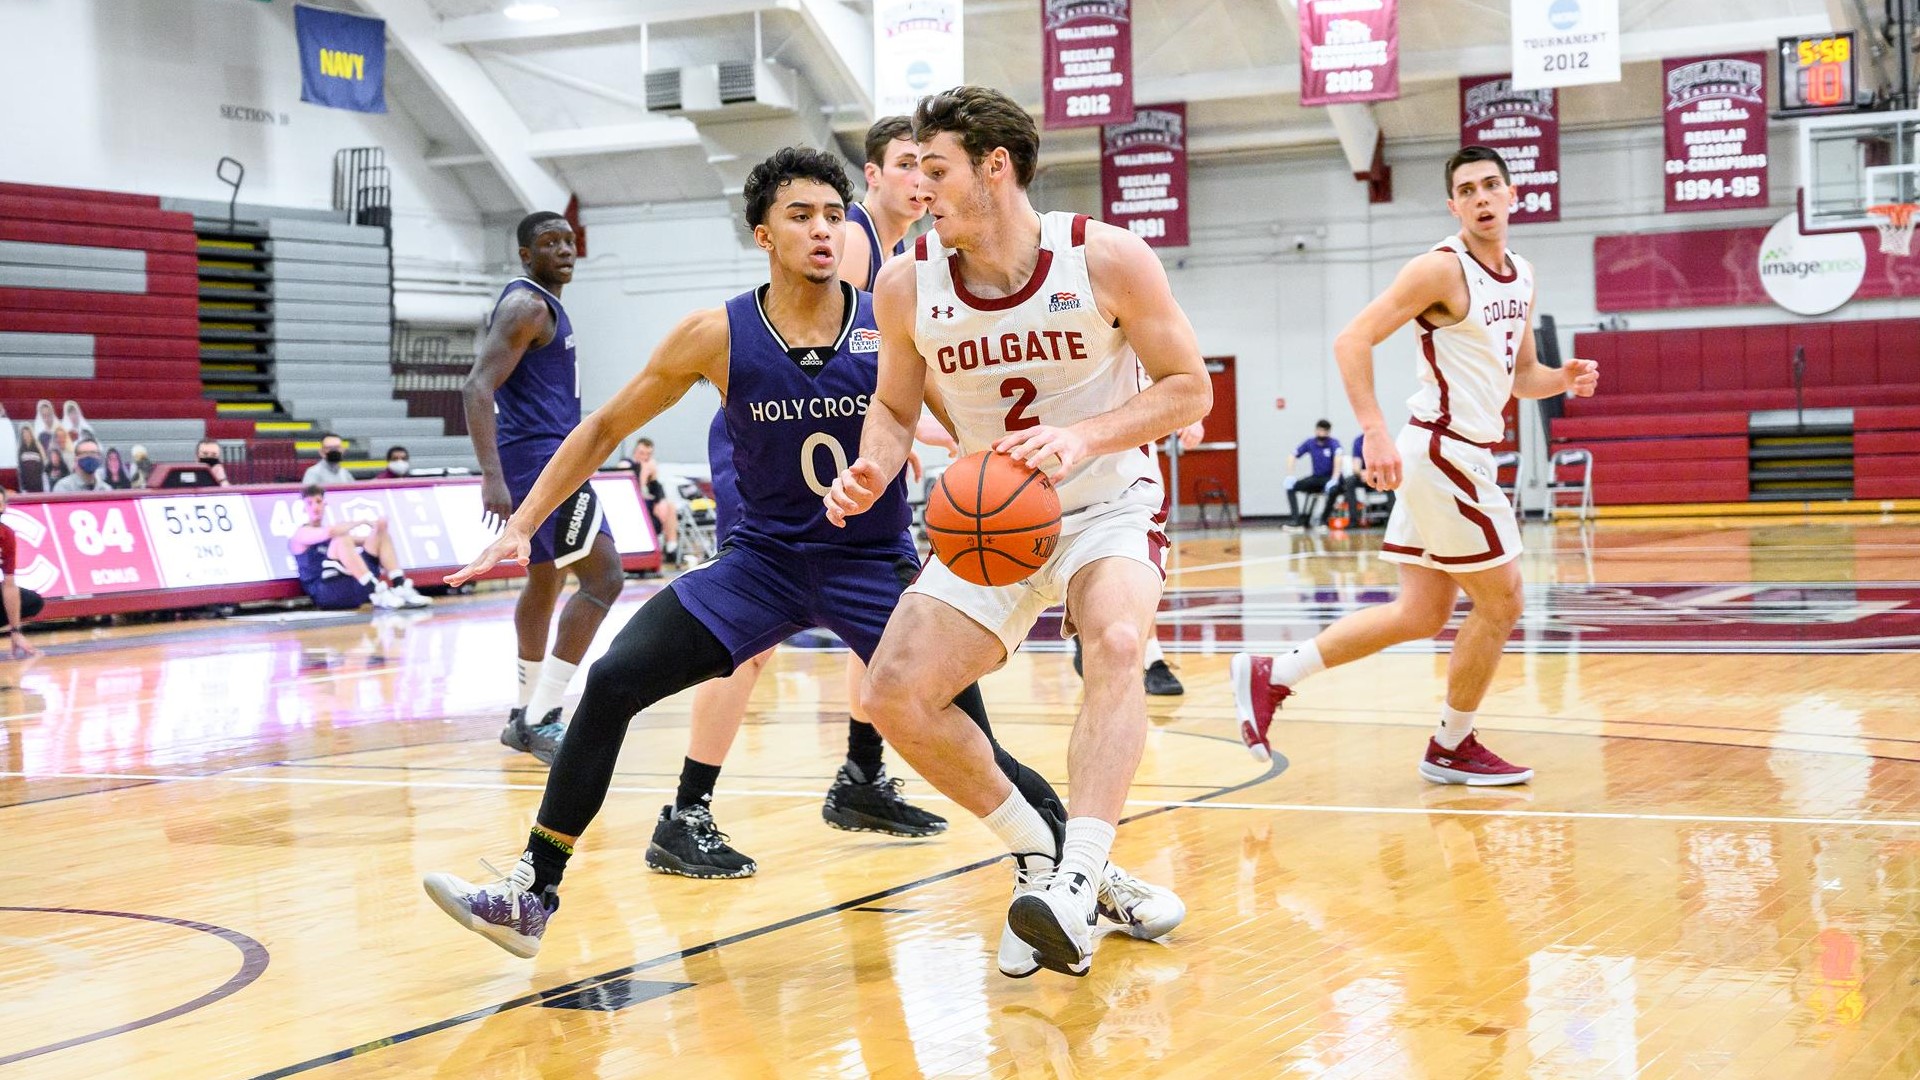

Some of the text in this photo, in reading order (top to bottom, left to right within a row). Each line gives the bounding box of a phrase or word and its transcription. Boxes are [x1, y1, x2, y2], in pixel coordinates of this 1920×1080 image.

[1523, 32, 1607, 49] TOURNAMENT
[1060, 47, 1115, 63] REGULAR
[1543, 51, 1589, 72] 2012
[1798, 37, 1849, 66] 5:58
[319, 48, 364, 80] NAVY
[1064, 61, 1111, 76] SEASON
[1053, 72, 1123, 91] CHAMPIONS
[1326, 69, 1374, 94] 2012
[220, 104, 274, 124] SECTION
[1066, 94, 1111, 117] 2012
[1681, 108, 1749, 124] BASKETBALL
[1478, 126, 1543, 141] BASKETBALL
[1684, 128, 1747, 145] REGULAR
[1688, 142, 1743, 158] SEASON
[1665, 153, 1767, 174] CO-CHAMPIONS
[1118, 172, 1171, 188] REGULAR
[1675, 176, 1760, 201] 1994-95
[1122, 186, 1168, 200] SEASON
[1111, 197, 1179, 214] CHAMPIONS
[1762, 257, 1862, 279] imagepress
[1049, 299, 1080, 308] PATRIOT
[1049, 303, 1081, 312] LEAGUE
[937, 331, 1087, 374] COLGATE
[1505, 331, 1514, 375] 5
[750, 394, 874, 422] HOLY CROS
[1000, 377, 1040, 431] 2
[801, 432, 848, 497] 0
[164, 504, 233, 535] 5:58
[565, 492, 591, 546] CRUSADERS
[68, 508, 135, 556] 84
[194, 544, 224, 559] 2ND
[91, 566, 140, 586] BONUS
